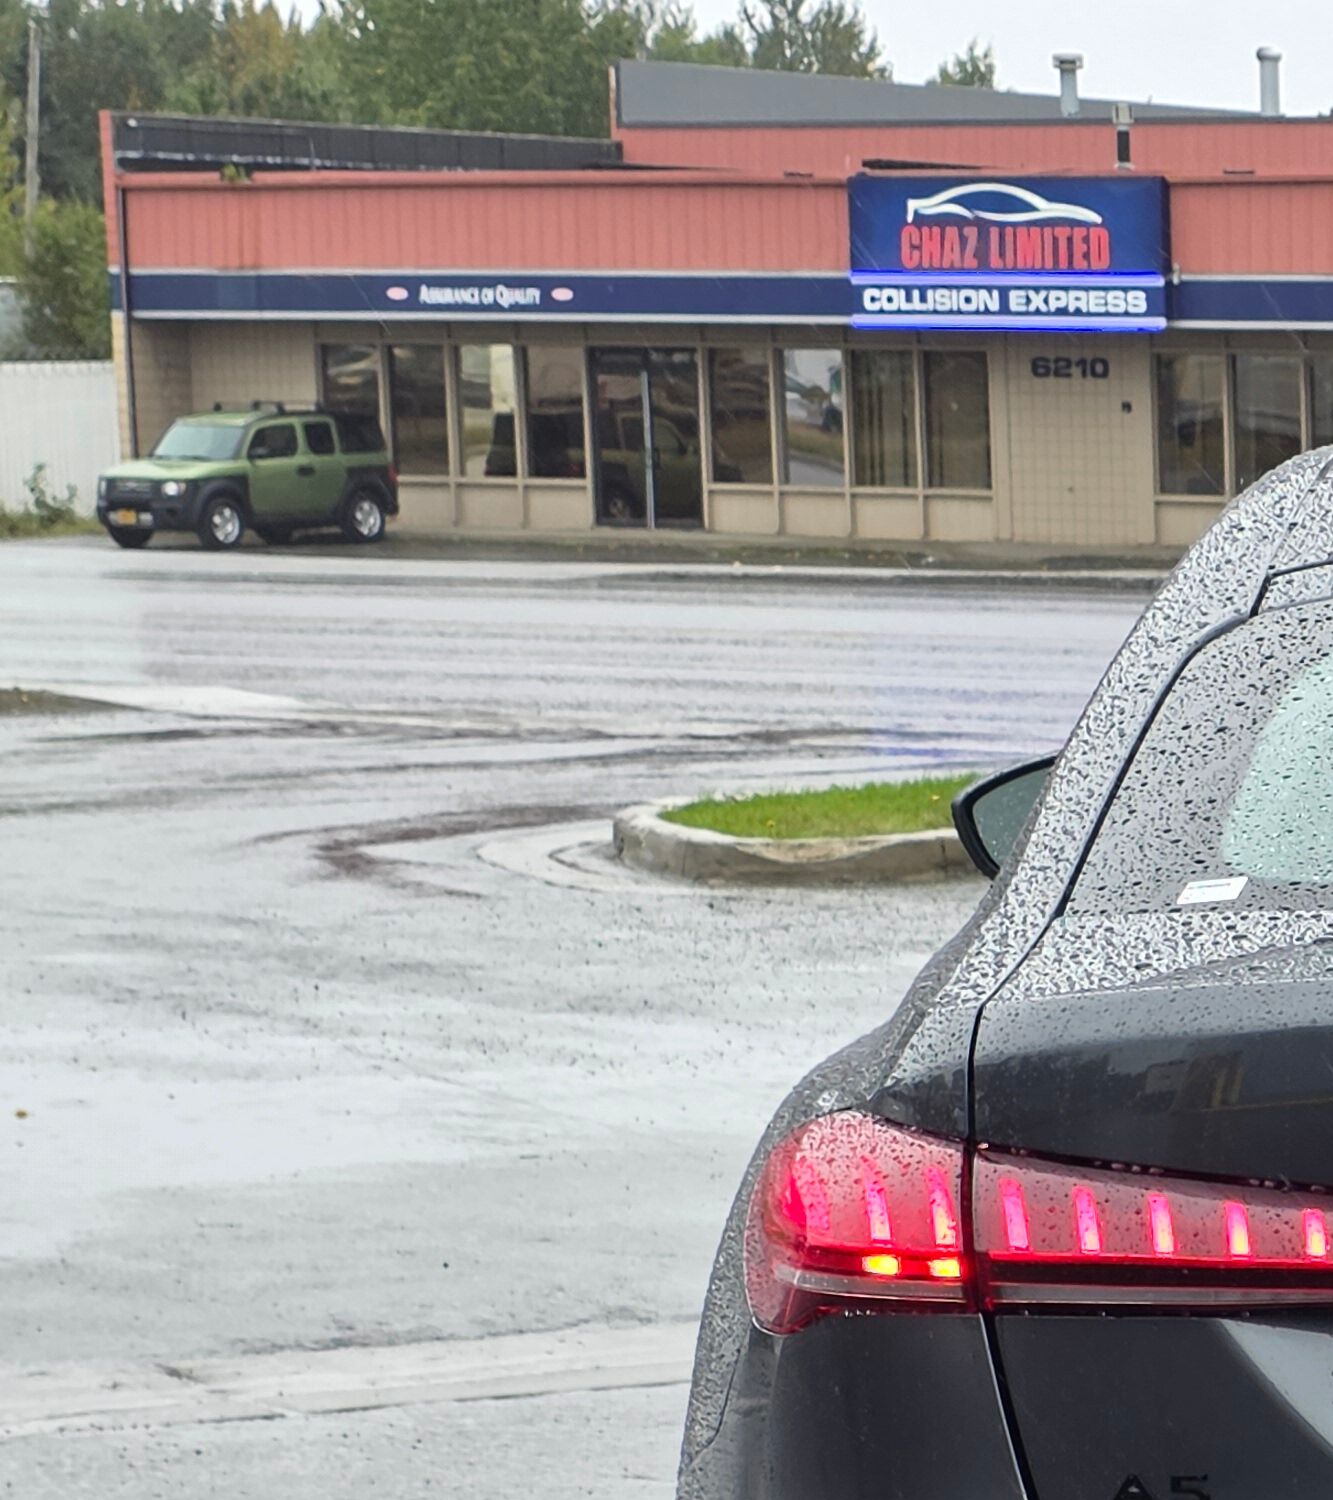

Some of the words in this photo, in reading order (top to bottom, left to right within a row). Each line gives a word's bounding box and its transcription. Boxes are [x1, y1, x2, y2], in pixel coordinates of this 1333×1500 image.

[901, 224, 979, 270] CHAZ
[989, 226, 1111, 270] LIMITED
[862, 287, 999, 312] COLLISION
[1009, 288, 1148, 315] EXPRESS
[1030, 356, 1110, 380] 6210
